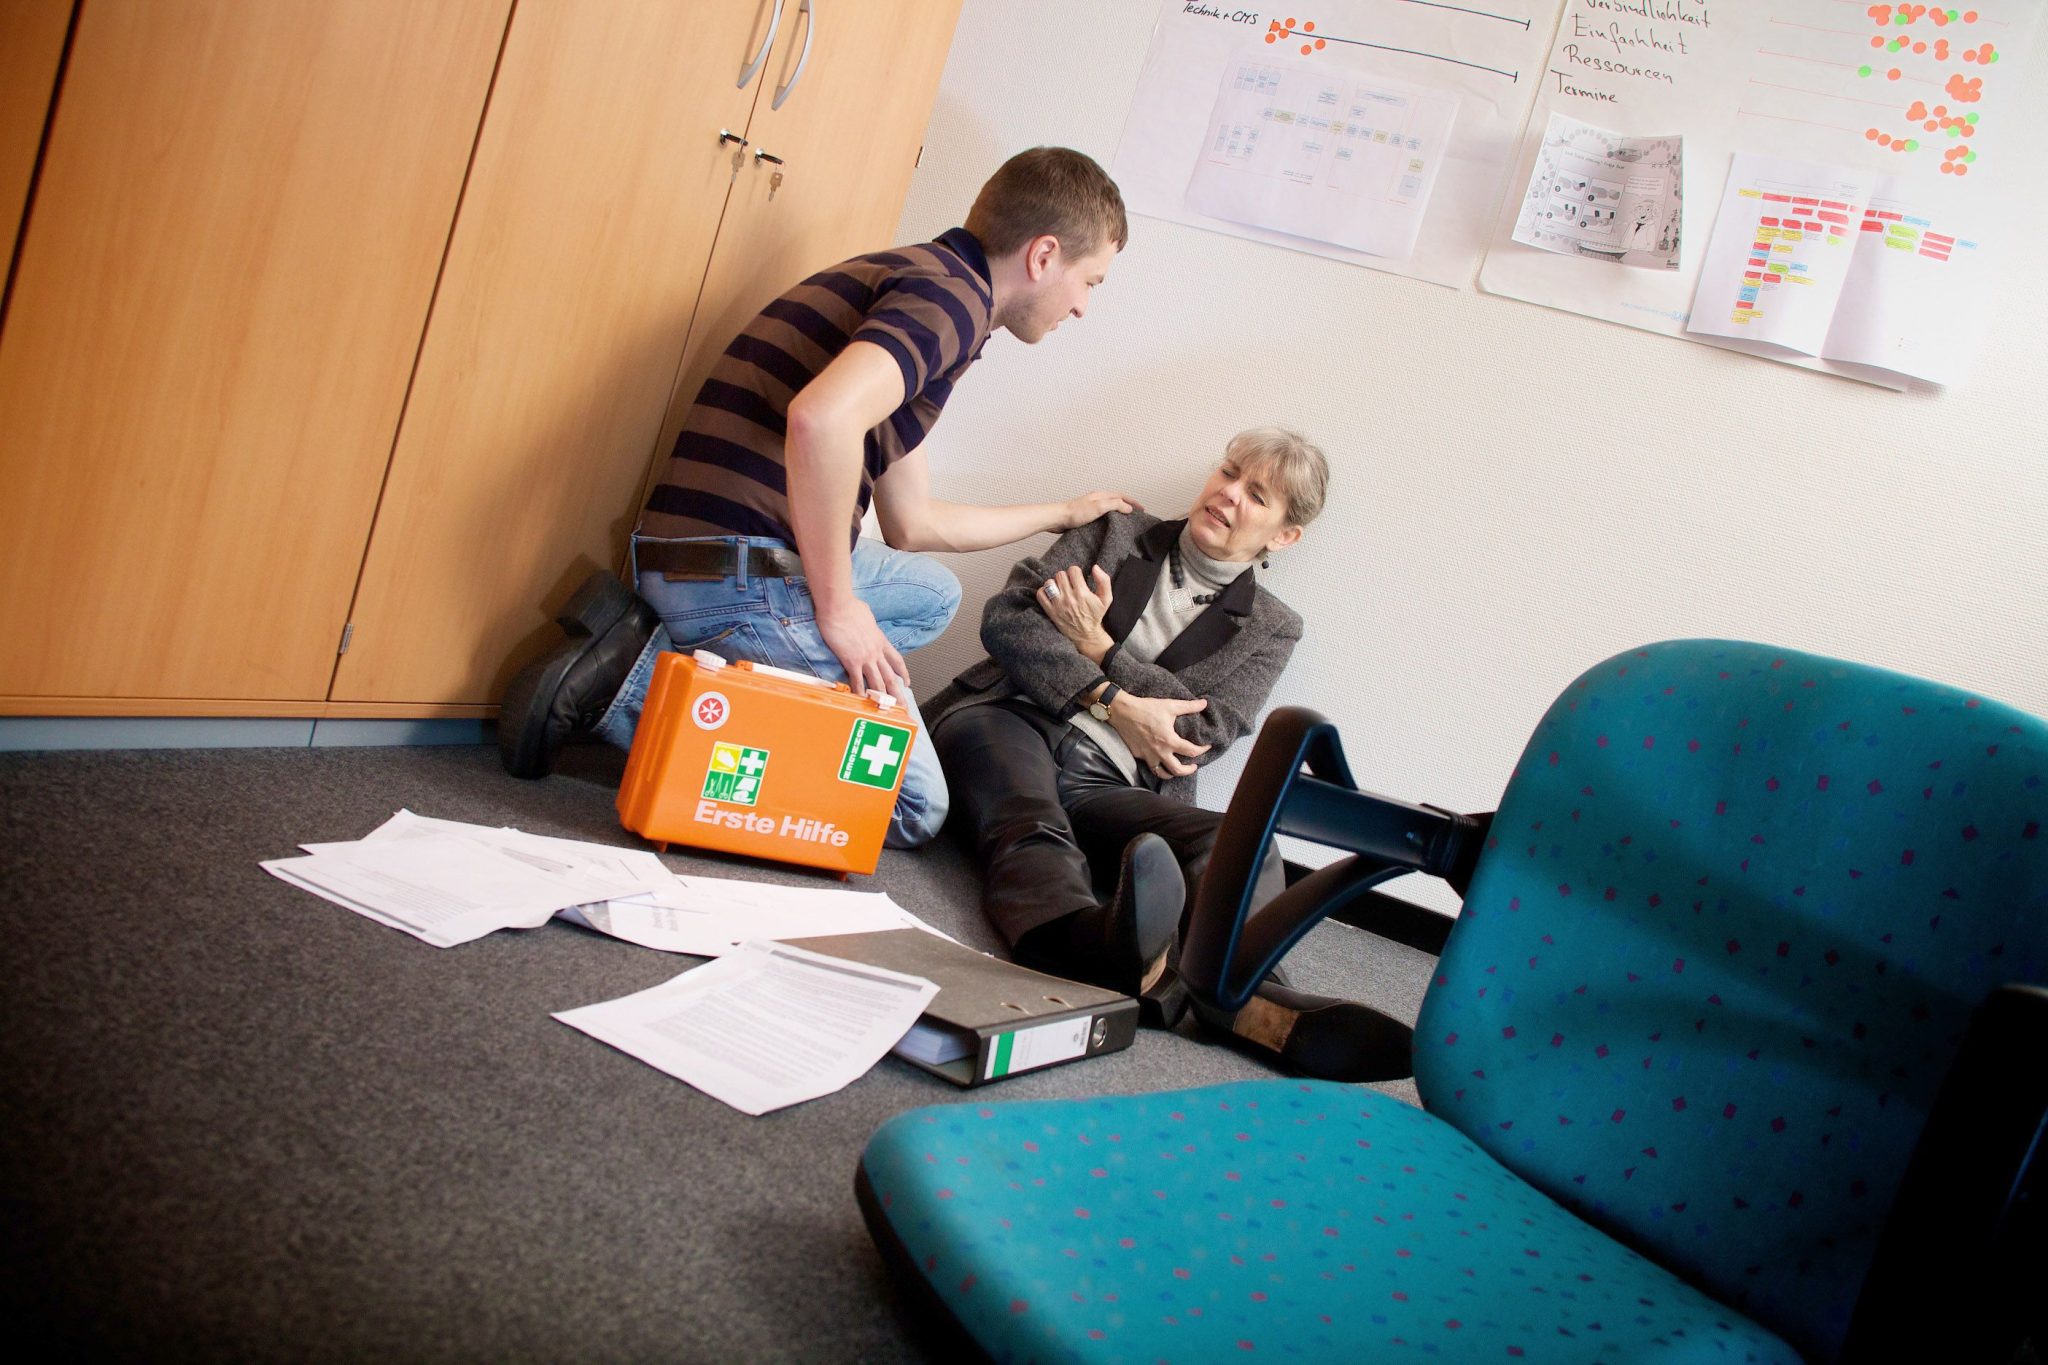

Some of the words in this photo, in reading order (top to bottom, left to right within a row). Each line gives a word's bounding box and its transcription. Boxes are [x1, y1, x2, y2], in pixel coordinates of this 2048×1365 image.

[1183, 0, 1220, 19] Technik
[1232, 10, 1259, 25] CMS
[1571, 13, 1688, 55] Einfachheit
[1562, 44, 1673, 84] Ressourcen
[1550, 69, 1619, 103] Termine
[694, 800, 776, 834] Erste
[779, 815, 850, 848] Hilfe
